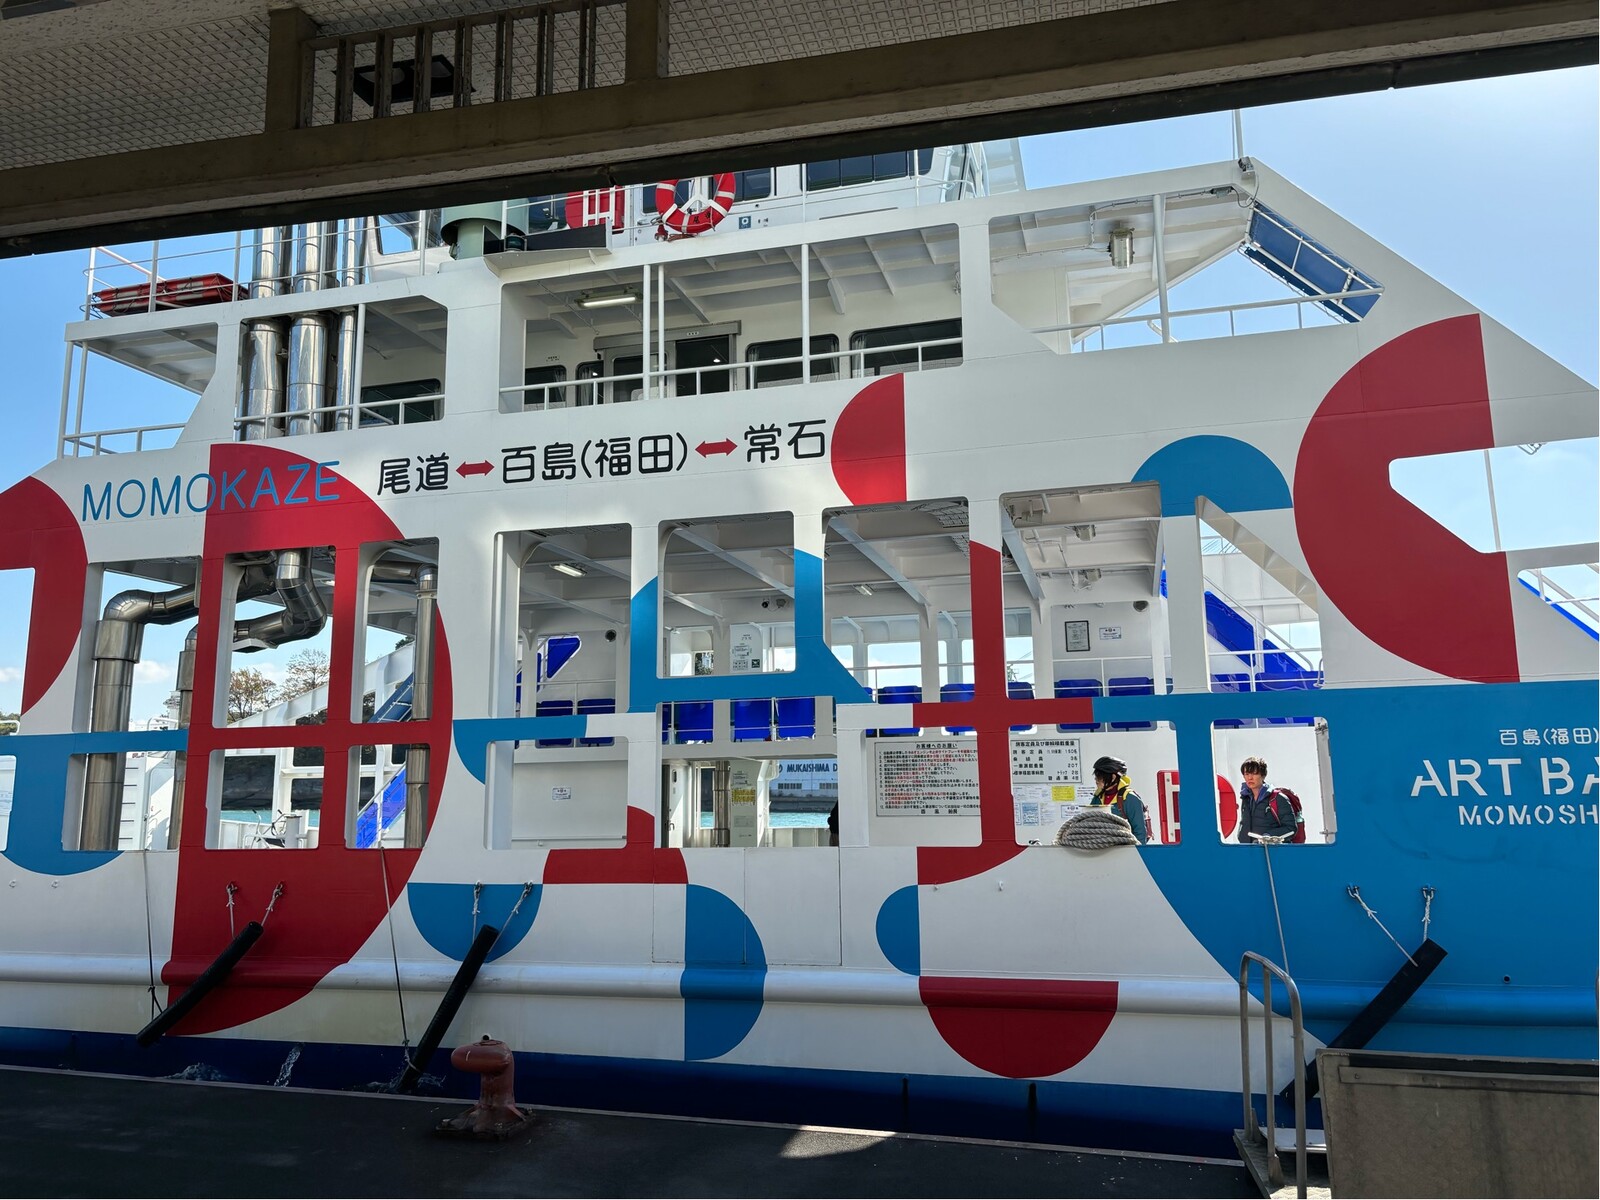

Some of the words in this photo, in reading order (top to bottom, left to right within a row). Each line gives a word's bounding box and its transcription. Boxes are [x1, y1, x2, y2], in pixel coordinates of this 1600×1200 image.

[377, 451, 450, 496] 尾道
[500, 431, 688, 484] 百島(福田)
[743, 418, 827, 463] 常石
[81, 460, 340, 522] MOMOKAZE
[787, 763, 830, 773] MUKAISHIMA
[1410, 757, 1522, 797] ART
[1458, 804, 1600, 826] MOMOSH
